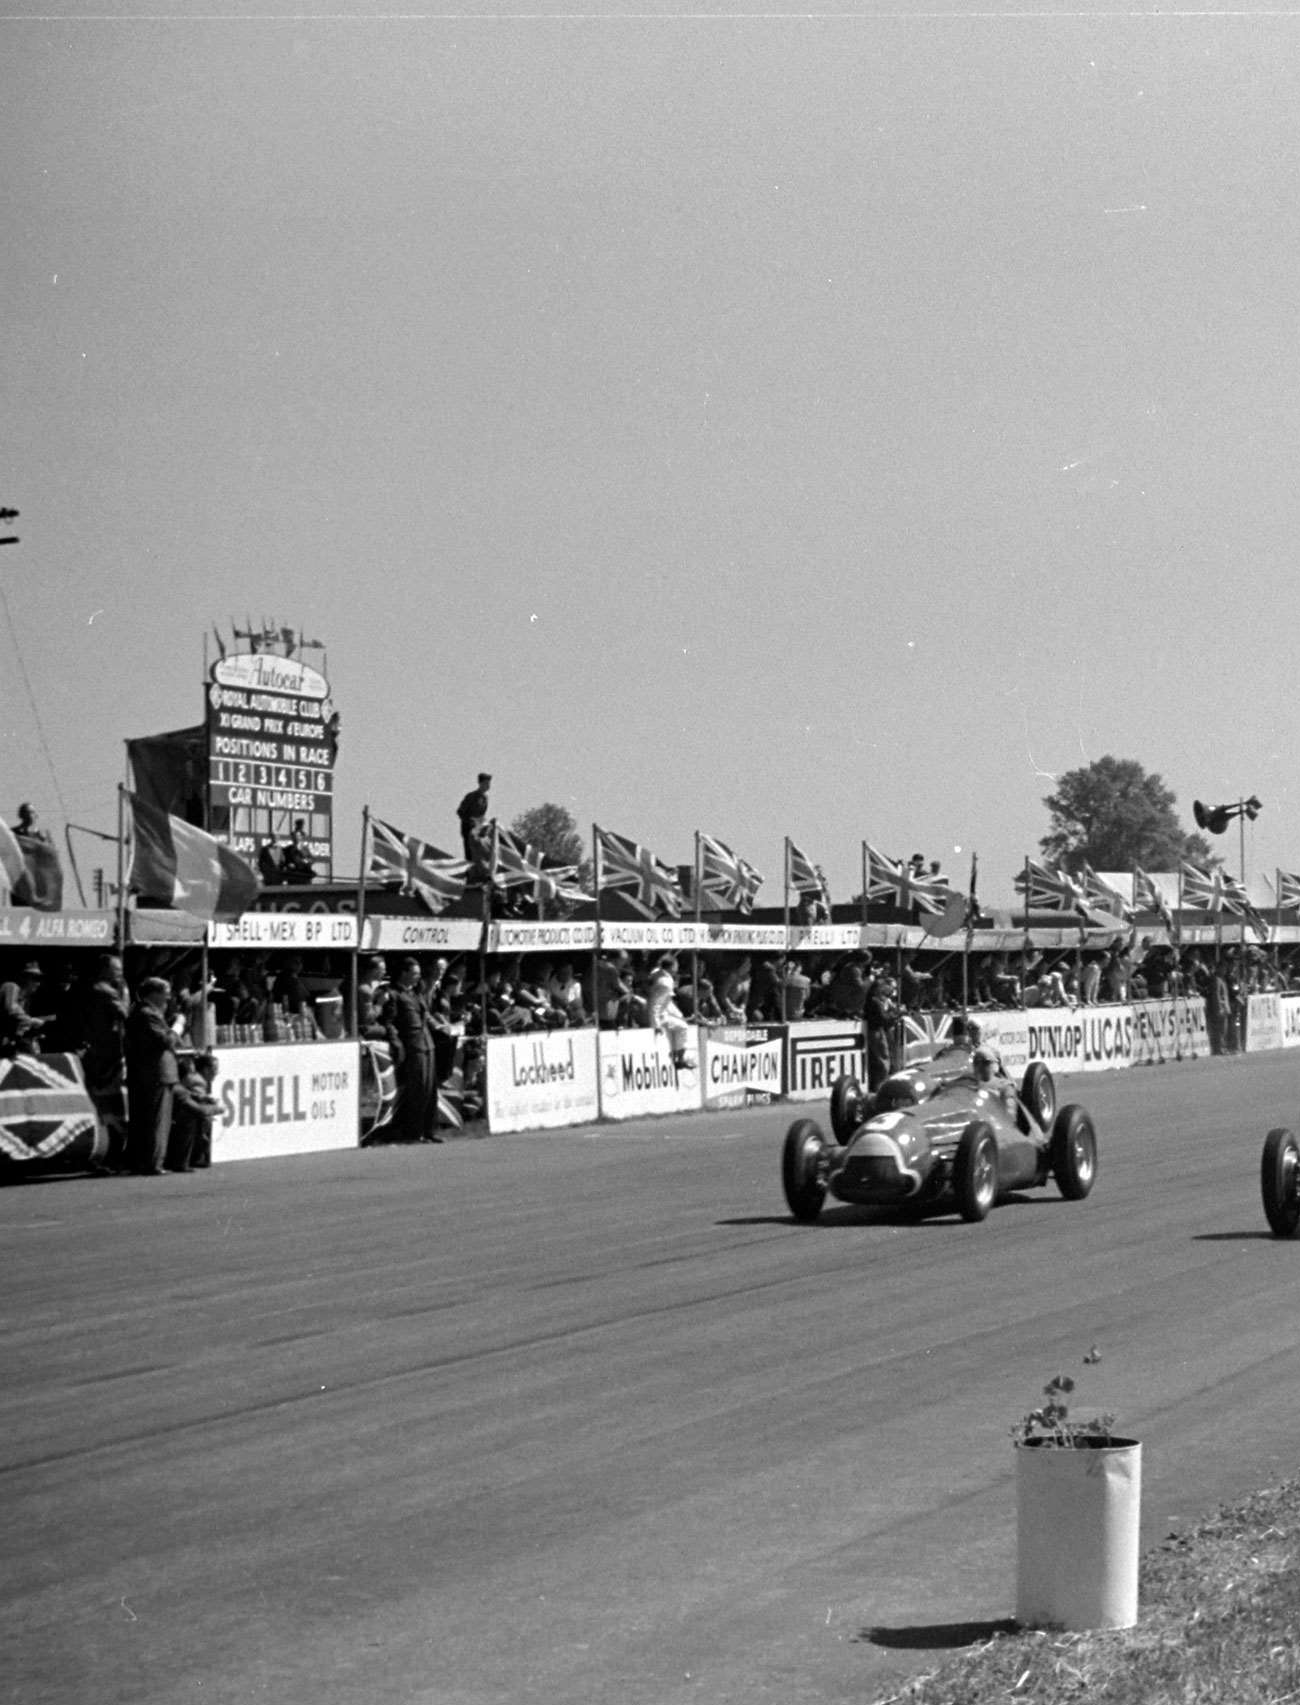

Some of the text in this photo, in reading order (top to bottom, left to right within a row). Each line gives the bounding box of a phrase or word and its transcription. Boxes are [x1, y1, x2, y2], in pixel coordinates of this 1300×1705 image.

[215, 735, 330, 766] POSITIONS IN RACE
[218, 761, 326, 792] 1 2 3 4 5 6
[227, 786, 316, 811] CAR NUMBERS
[226, 920, 297, 943] SHELL-MEX
[331, 920, 353, 942] LTD
[402, 925, 449, 944] CONTROL
[610, 928, 644, 945] VACUUM
[646, 928, 660, 944] OIL
[662, 928, 674, 944] CO
[678, 927, 696, 944] LTD
[840, 929, 859, 945] LTD
[1083, 1016, 1132, 1062] LUCAS
[1133, 1008, 1176, 1040] HENLYS
[1028, 1024, 1082, 1060] DUNLOP
[511, 1038, 575, 1087] Lockheed
[711, 1051, 779, 1085] CHAMPION
[311, 1071, 349, 1091] MOTOR
[221, 1075, 306, 1128] SHELL
[310, 1099, 336, 1120] OILS
